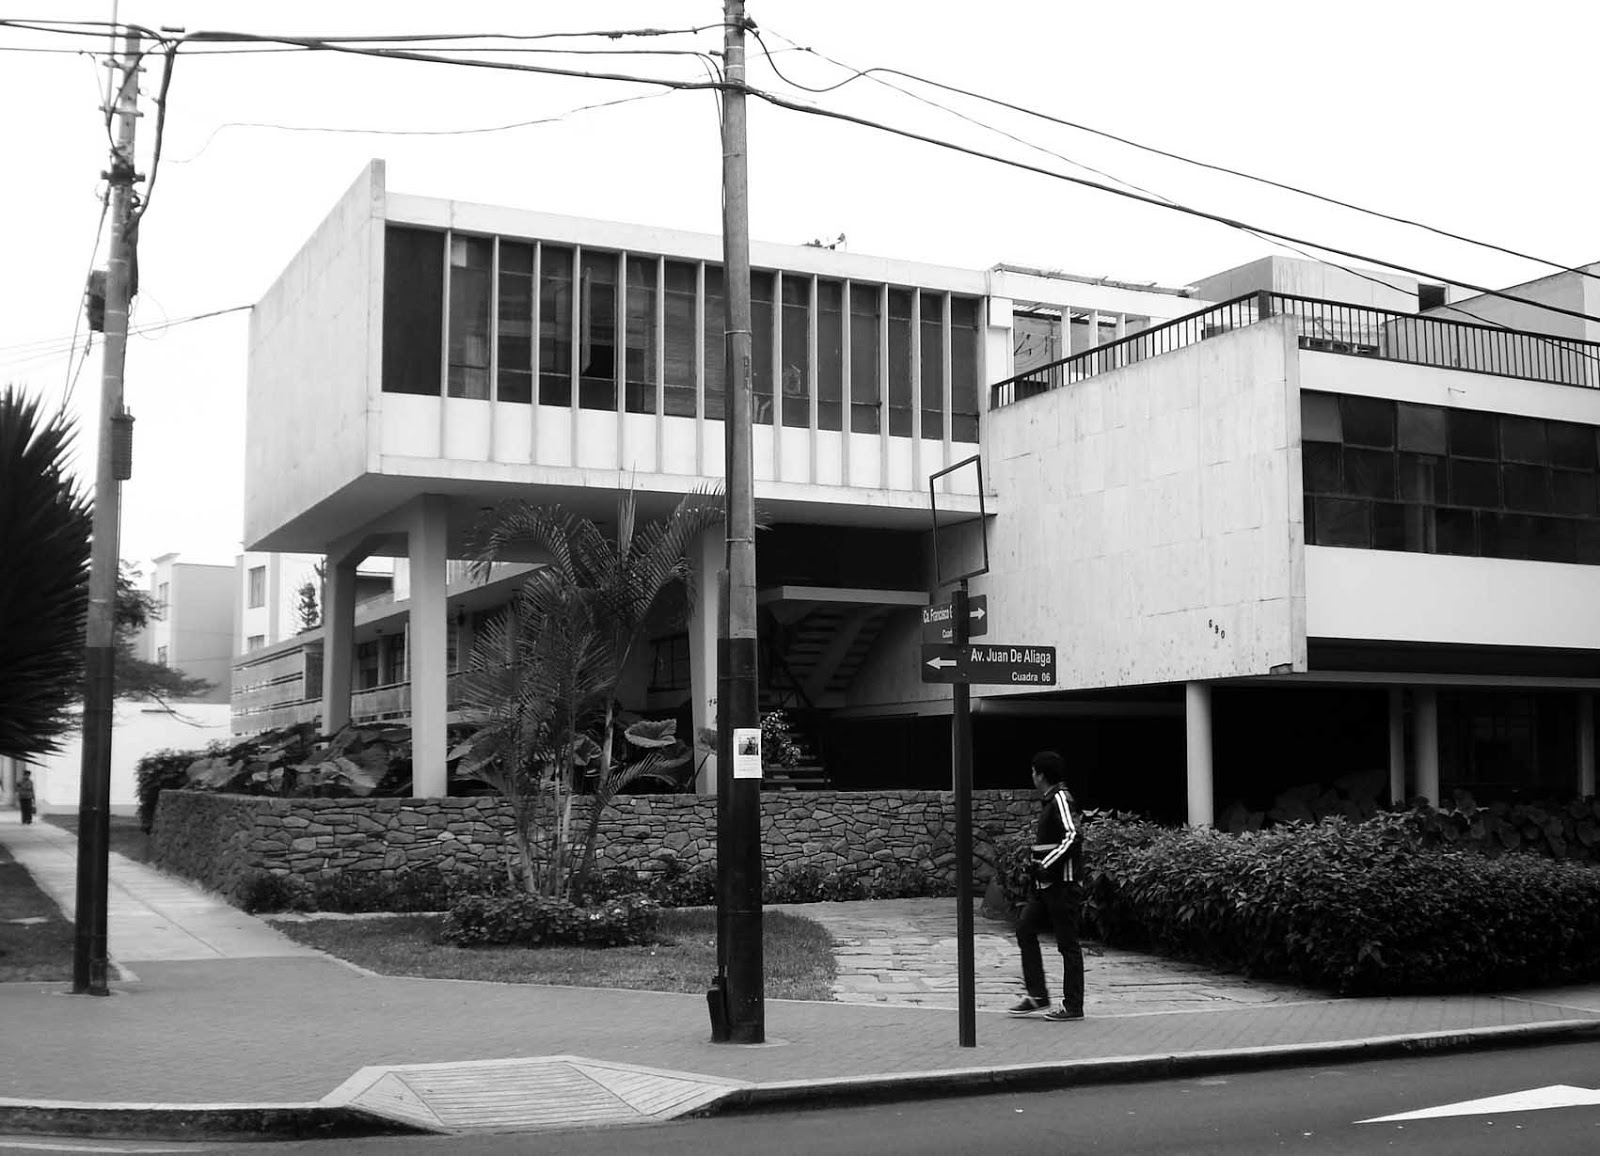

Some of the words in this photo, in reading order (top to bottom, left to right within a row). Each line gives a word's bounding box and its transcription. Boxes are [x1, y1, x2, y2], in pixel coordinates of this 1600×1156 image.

[930, 607, 949, 621] Francisco
[1208, 619, 1226, 639] 690
[971, 647, 985, 662] Av.
[986, 648, 1008, 662] Juan
[1010, 649, 1022, 662] De
[1023, 649, 1051, 667] Aliaga
[1011, 671, 1038, 681] Cuadra
[1041, 672, 1051, 681] 06
